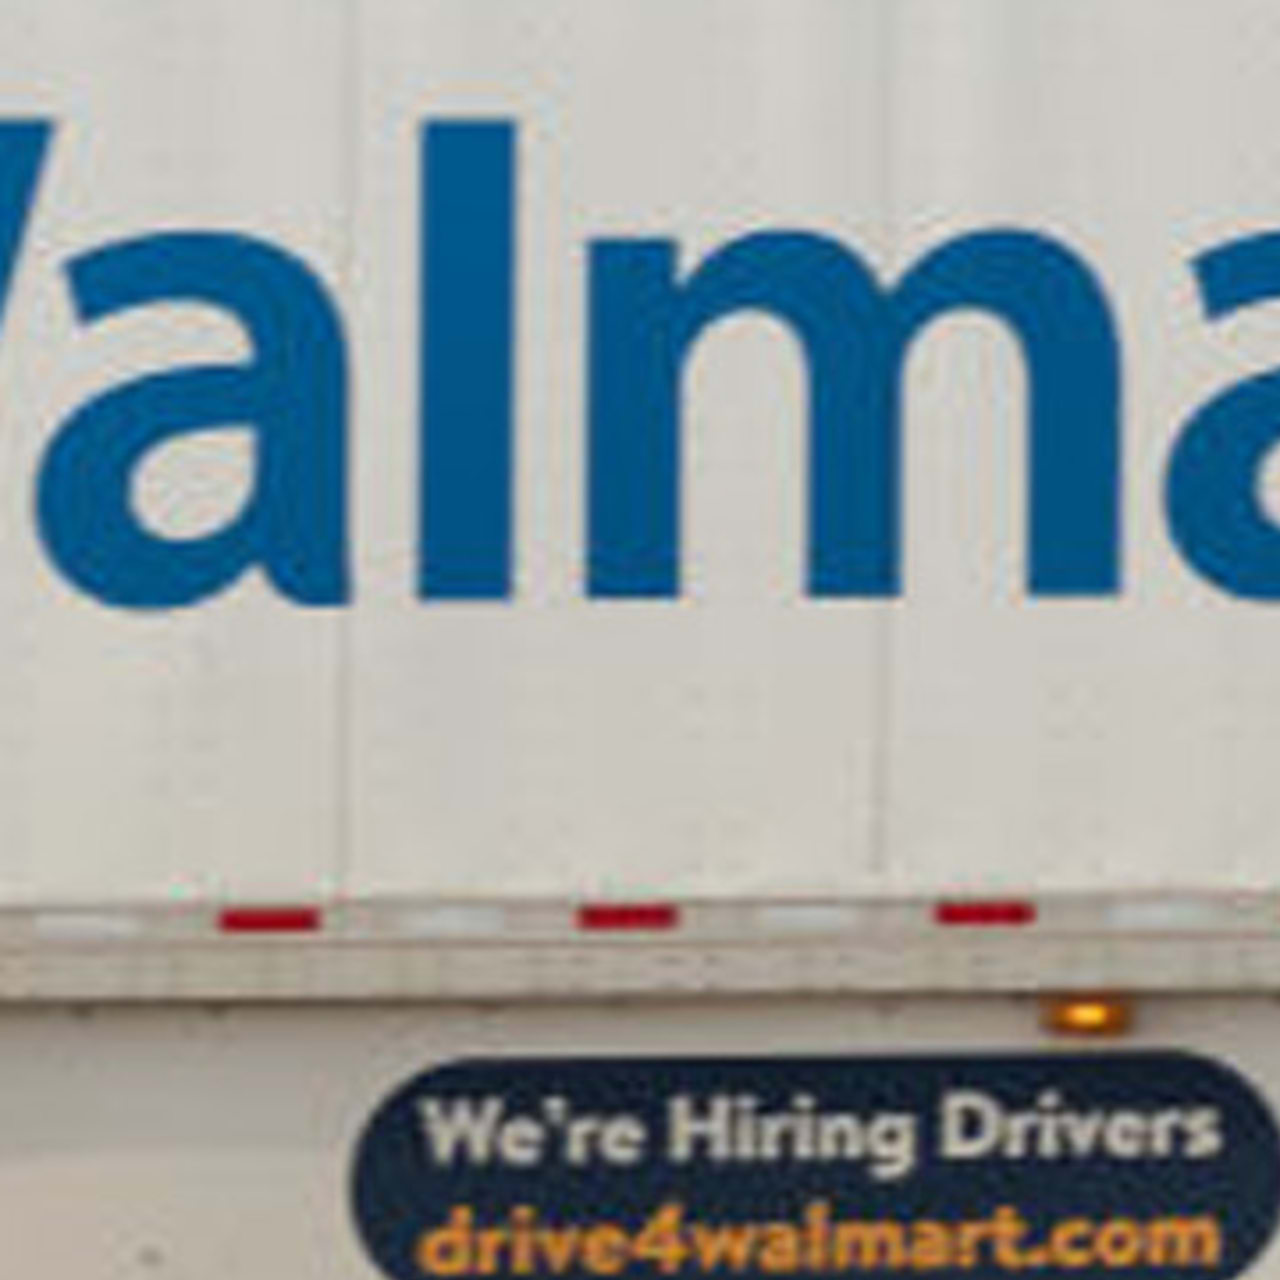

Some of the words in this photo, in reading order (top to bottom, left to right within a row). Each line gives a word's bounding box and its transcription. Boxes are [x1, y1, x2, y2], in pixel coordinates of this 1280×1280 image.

[420, 1097, 646, 1166] We're
[667, 1093, 917, 1180] Hiring
[938, 1090, 1224, 1162] Drivers
[416, 1202, 1224, 1276] drive4walmart.com
